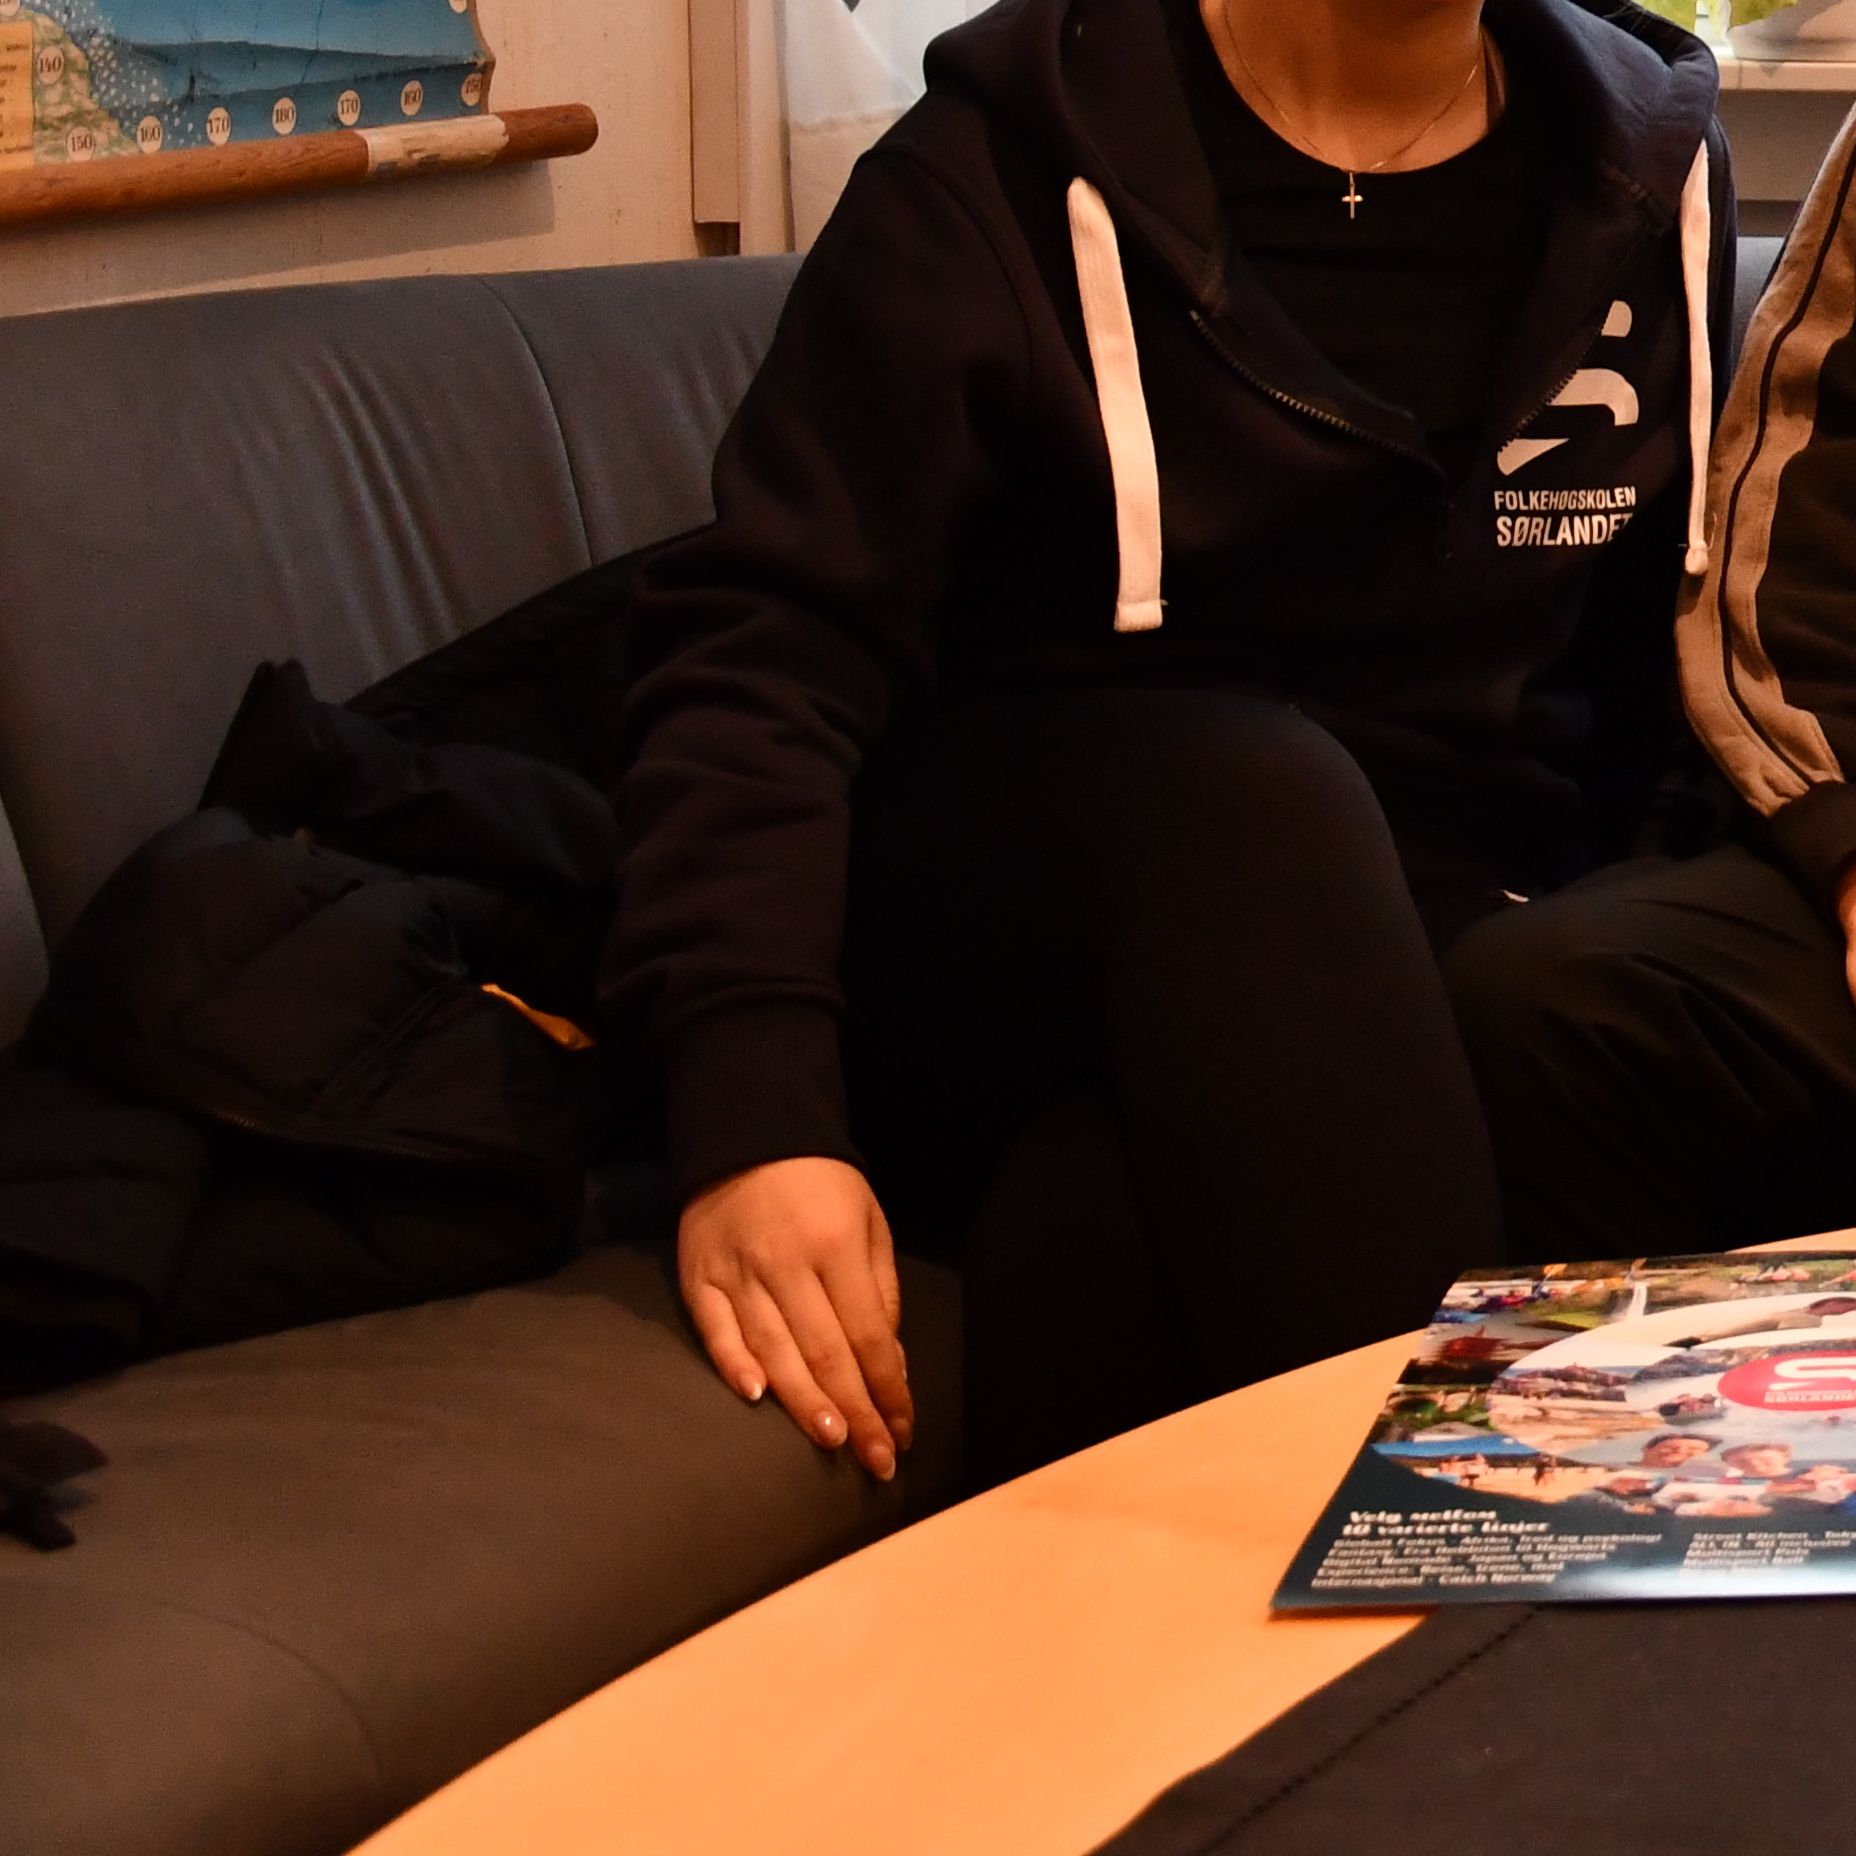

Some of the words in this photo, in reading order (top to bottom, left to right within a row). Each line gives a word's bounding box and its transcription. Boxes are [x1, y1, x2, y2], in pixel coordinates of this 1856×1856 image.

[208, 116, 230, 134] 170
[340, 97, 360, 115] 170
[70, 134, 95, 152] 150
[1494, 485, 1636, 512] FOLKEHØGSKOLEN
[1350, 1510, 1401, 1525] Velg
[1409, 1508, 1497, 1522] mellom
[1342, 1523, 1371, 1536] 10
[1378, 1522, 1475, 1535] varierte
[1480, 1520, 1549, 1534] linjer
